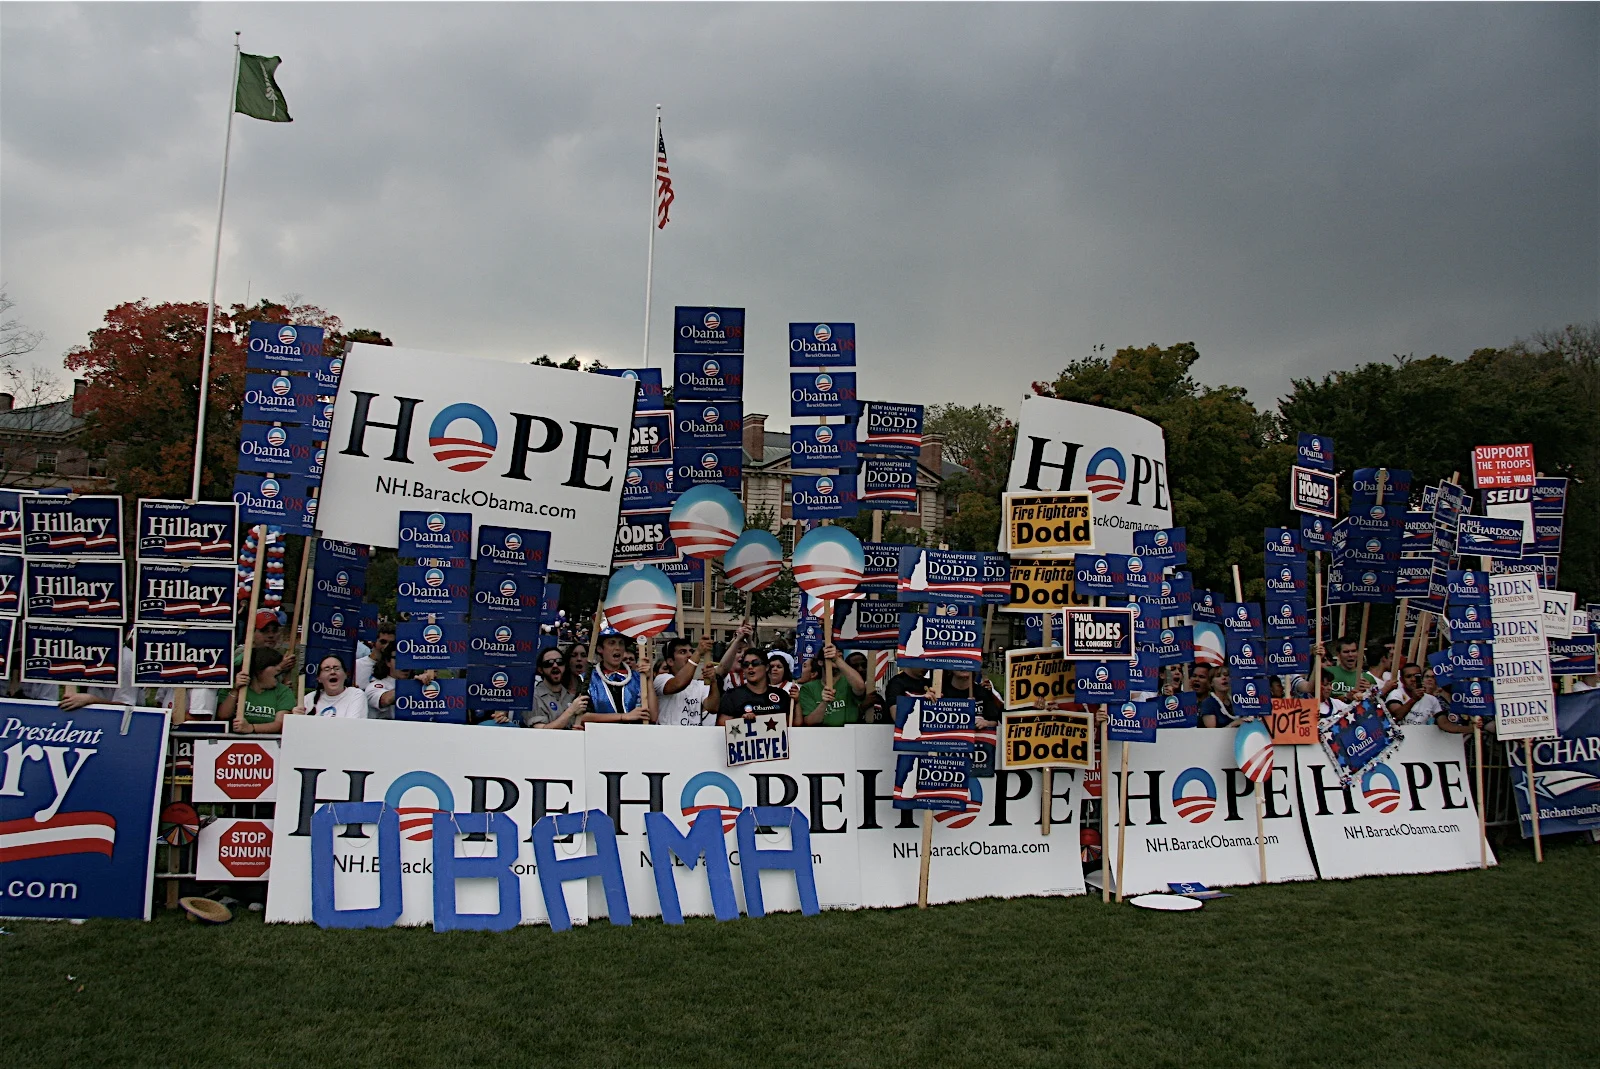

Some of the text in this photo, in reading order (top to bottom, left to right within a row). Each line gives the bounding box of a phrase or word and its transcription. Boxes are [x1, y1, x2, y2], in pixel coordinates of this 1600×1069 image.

[681, 325, 725, 338] Obama
[250, 338, 319, 356] Obama '08
[791, 338, 837, 351] Obama
[680, 373, 724, 385] Obama
[246, 390, 314, 407] Obama '08
[792, 388, 838, 402] Obama
[680, 420, 724, 432] Obama
[870, 414, 917, 428] DODD
[339, 390, 619, 492] HOPE
[792, 441, 838, 453] Obama
[241, 441, 310, 459] Obama '08
[1476, 446, 1529, 460] SUPPORT
[679, 466, 722, 477] Obama
[1477, 460, 1531, 470] THE TROOPS
[867, 471, 912, 483] DODD
[1020, 436, 1168, 511] HOPE
[1478, 475, 1532, 484] END THE WAR
[1299, 480, 1328, 500] HODES
[1487, 489, 1529, 503] SEIU
[234, 492, 303, 511] Obama '08
[376, 475, 576, 520] NH.BarackObama.com
[793, 492, 839, 505] Obama
[1012, 505, 1088, 521] Fire Fighters
[31, 512, 111, 538] Hillary
[148, 517, 227, 544] Hillary
[1017, 520, 1090, 544] Dodd
[1405, 521, 1434, 530] HARDSON
[1460, 523, 1523, 537] RICHARDSON
[401, 528, 468, 542] Obama '08
[616, 524, 663, 544] ODES
[481, 544, 542, 560] Obama '08
[622, 544, 653, 552] CONGRESS
[1135, 545, 1173, 556] Obama
[929, 562, 978, 576] DODD
[1078, 570, 1111, 582] Obama
[35, 576, 114, 602] Hillary
[399, 583, 468, 598] Obama '08
[1267, 579, 1295, 589] Obama
[1448, 583, 1478, 594] Obama
[1489, 580, 1533, 596] BIDEN
[148, 579, 227, 606] Hillary
[476, 591, 536, 606] Obama '08
[1494, 595, 1525, 604] PRESIDENT
[1268, 615, 1295, 625] Obama
[1450, 619, 1481, 629] Obama
[925, 627, 976, 641] DODD
[1075, 623, 1120, 640] HODES
[1493, 621, 1538, 636] BIDEN
[397, 640, 467, 653] Obama '08
[471, 638, 515, 651] Obama
[1497, 636, 1530, 644] PRESIDENT
[33, 638, 111, 667] Hillary
[144, 642, 223, 668] Hillary
[1269, 654, 1296, 663] Obama
[1453, 656, 1483, 666] Obama
[1011, 664, 1032, 678] Fire
[1496, 660, 1543, 677] BIDEN
[1078, 679, 1112, 690] Obama
[1502, 677, 1534, 685] PRESIDENT
[468, 684, 528, 697] Obama '08
[396, 696, 464, 709] Obama '08
[1271, 699, 1302, 711] BAMA
[1501, 700, 1547, 717] BIDEN
[923, 710, 970, 724] DODD
[1262, 708, 1310, 739] VOTE
[1, 718, 103, 745] President
[744, 720, 757, 737] I
[1008, 723, 1087, 738] Fire Fighters
[728, 730, 787, 764] BELIEVE!
[1013, 739, 1087, 761] Dodd
[228, 754, 262, 765] STOP
[217, 768, 271, 780] SUNUNU
[919, 768, 965, 782] DODD
[1307, 761, 1468, 815] HOPE
[599, 770, 847, 835] HOPE
[1112, 766, 1292, 827] HOPE
[288, 768, 573, 843] HOPE
[232, 832, 266, 843] STOP
[1344, 824, 1460, 840] NH.BarackObama.com
[893, 841, 1049, 859] NH.arackObama.com
[1146, 834, 1279, 853] NH.BarackObama.com
[311, 802, 820, 932] OBAMA
